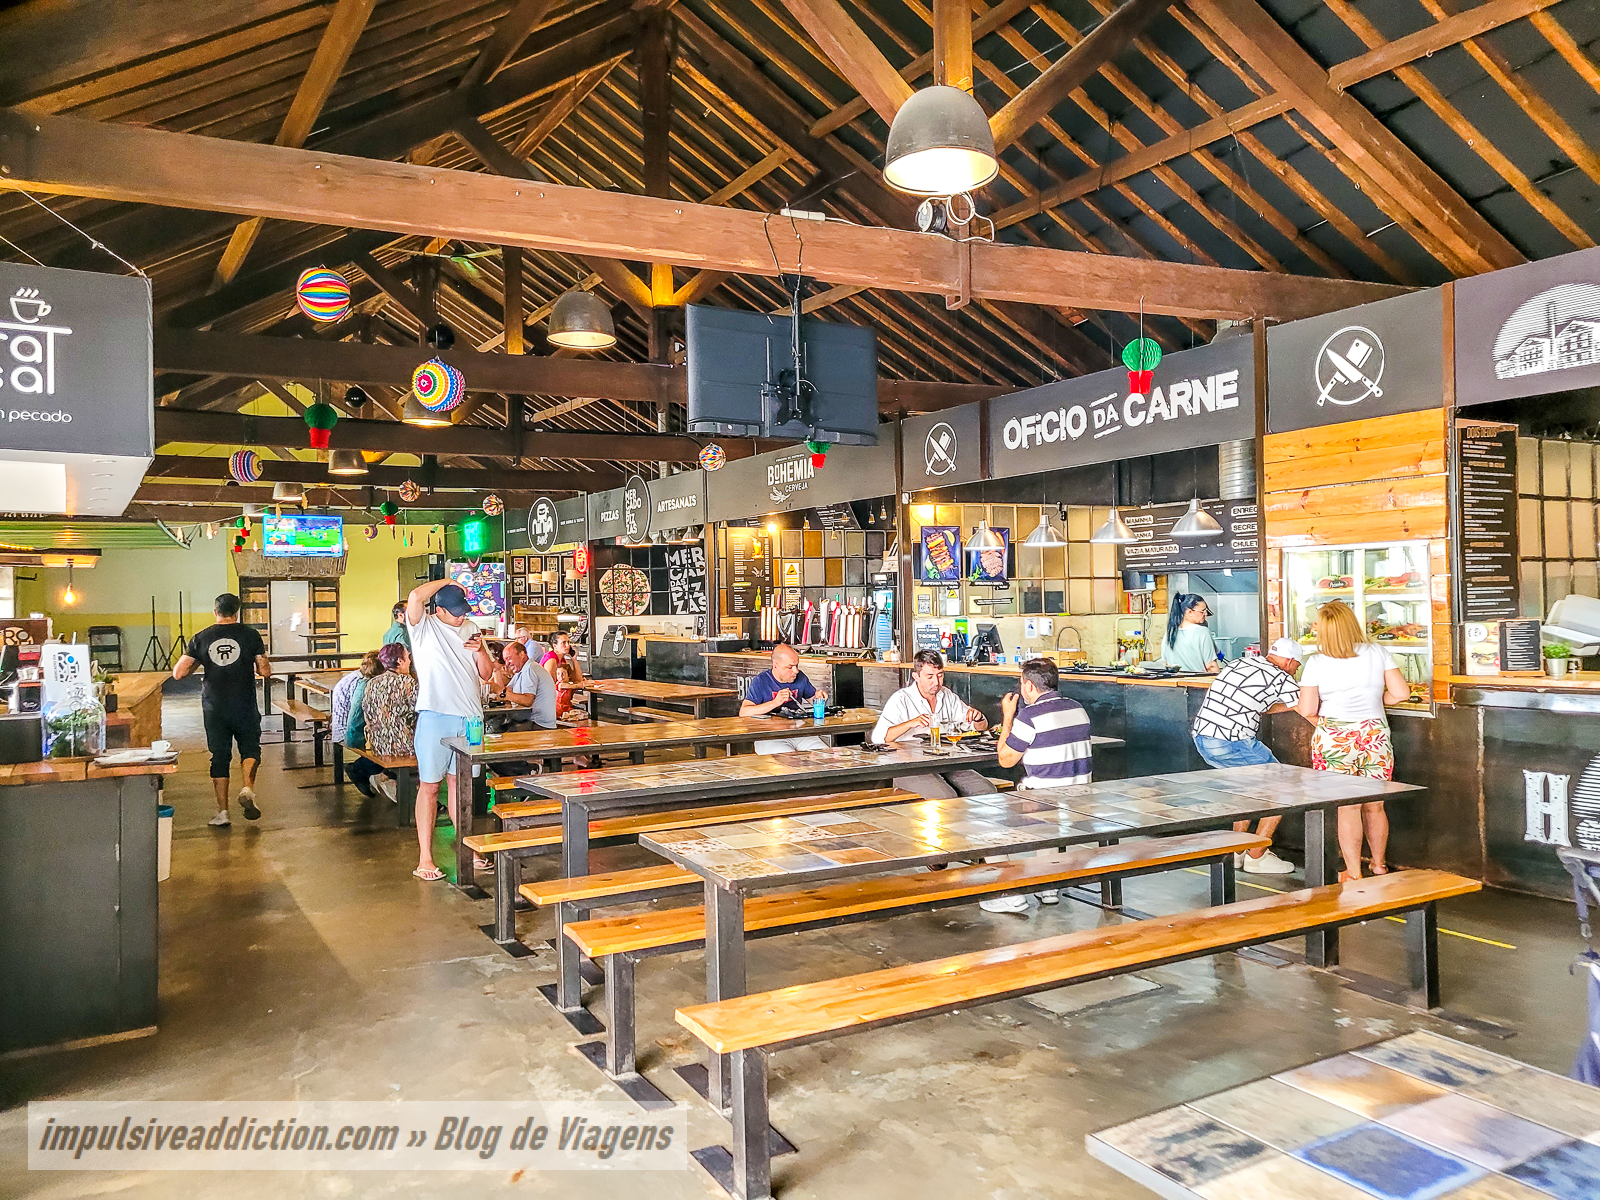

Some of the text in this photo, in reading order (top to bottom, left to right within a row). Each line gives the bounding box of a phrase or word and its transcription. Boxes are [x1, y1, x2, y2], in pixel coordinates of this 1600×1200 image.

[1093, 403, 1119, 429] DA
[1123, 369, 1239, 428] CARNE
[9, 410, 73, 423] pecado
[767, 457, 815, 486] BOHEMIA
[785, 481, 808, 493] CERVEJA
[657, 494, 697, 513] ARTESANAIS
[600, 509, 619, 522] PIZZAS
[664, 546, 705, 568] MER
